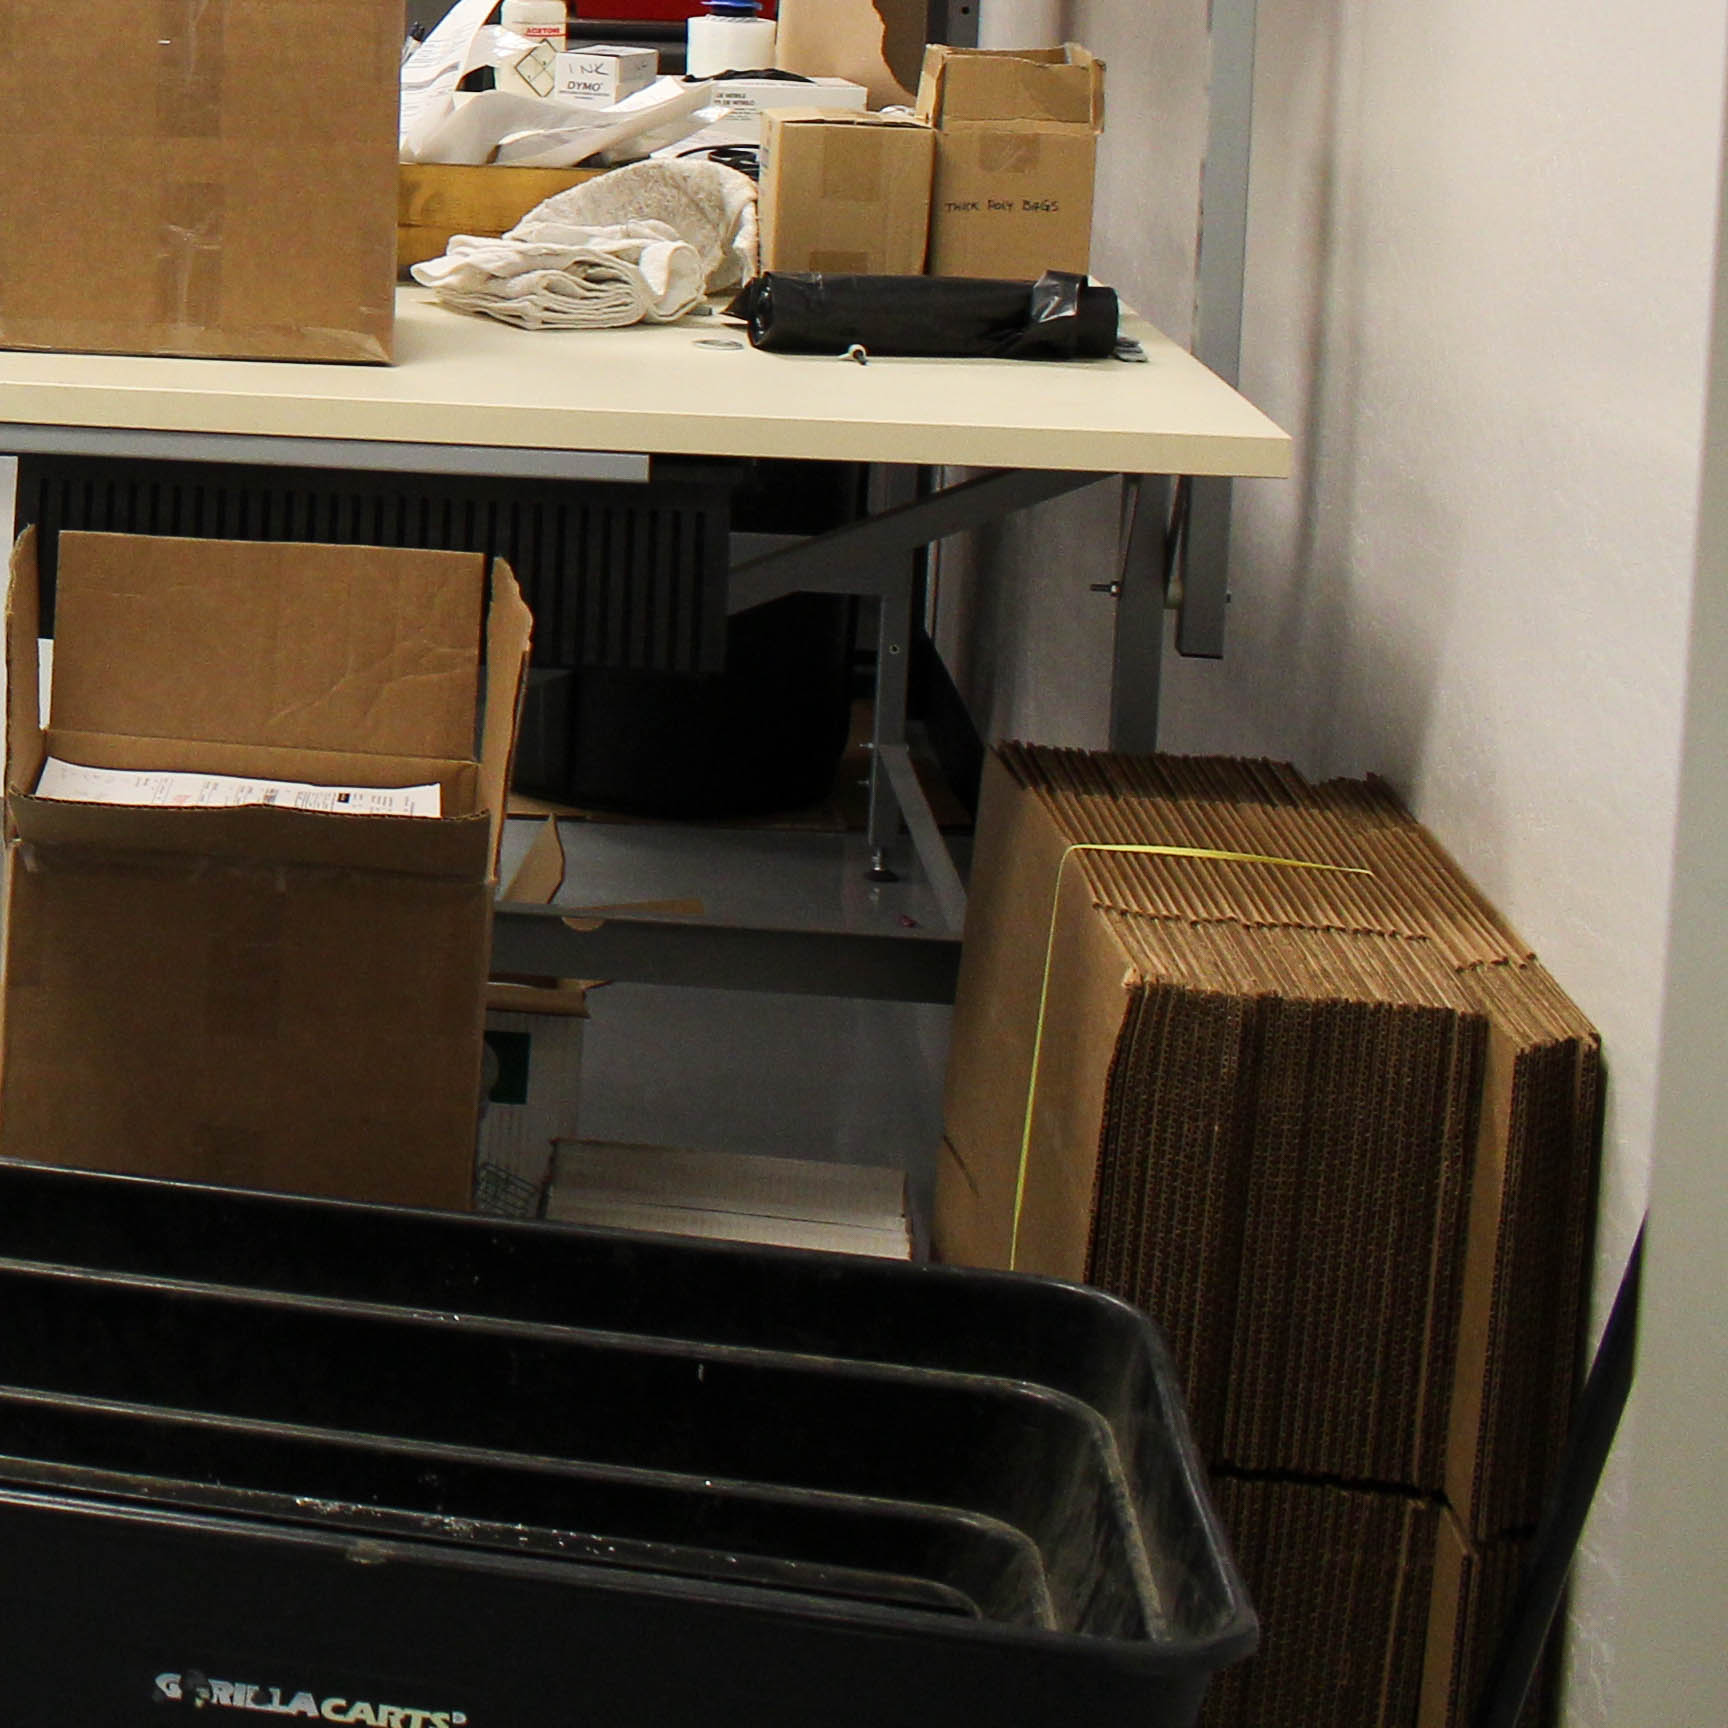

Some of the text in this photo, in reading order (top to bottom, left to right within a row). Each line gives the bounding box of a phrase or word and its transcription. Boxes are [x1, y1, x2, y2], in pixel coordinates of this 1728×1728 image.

[569, 63, 608, 76] INK
[567, 80, 601, 92] DYMO
[1022, 199, 1059, 212] BAGS
